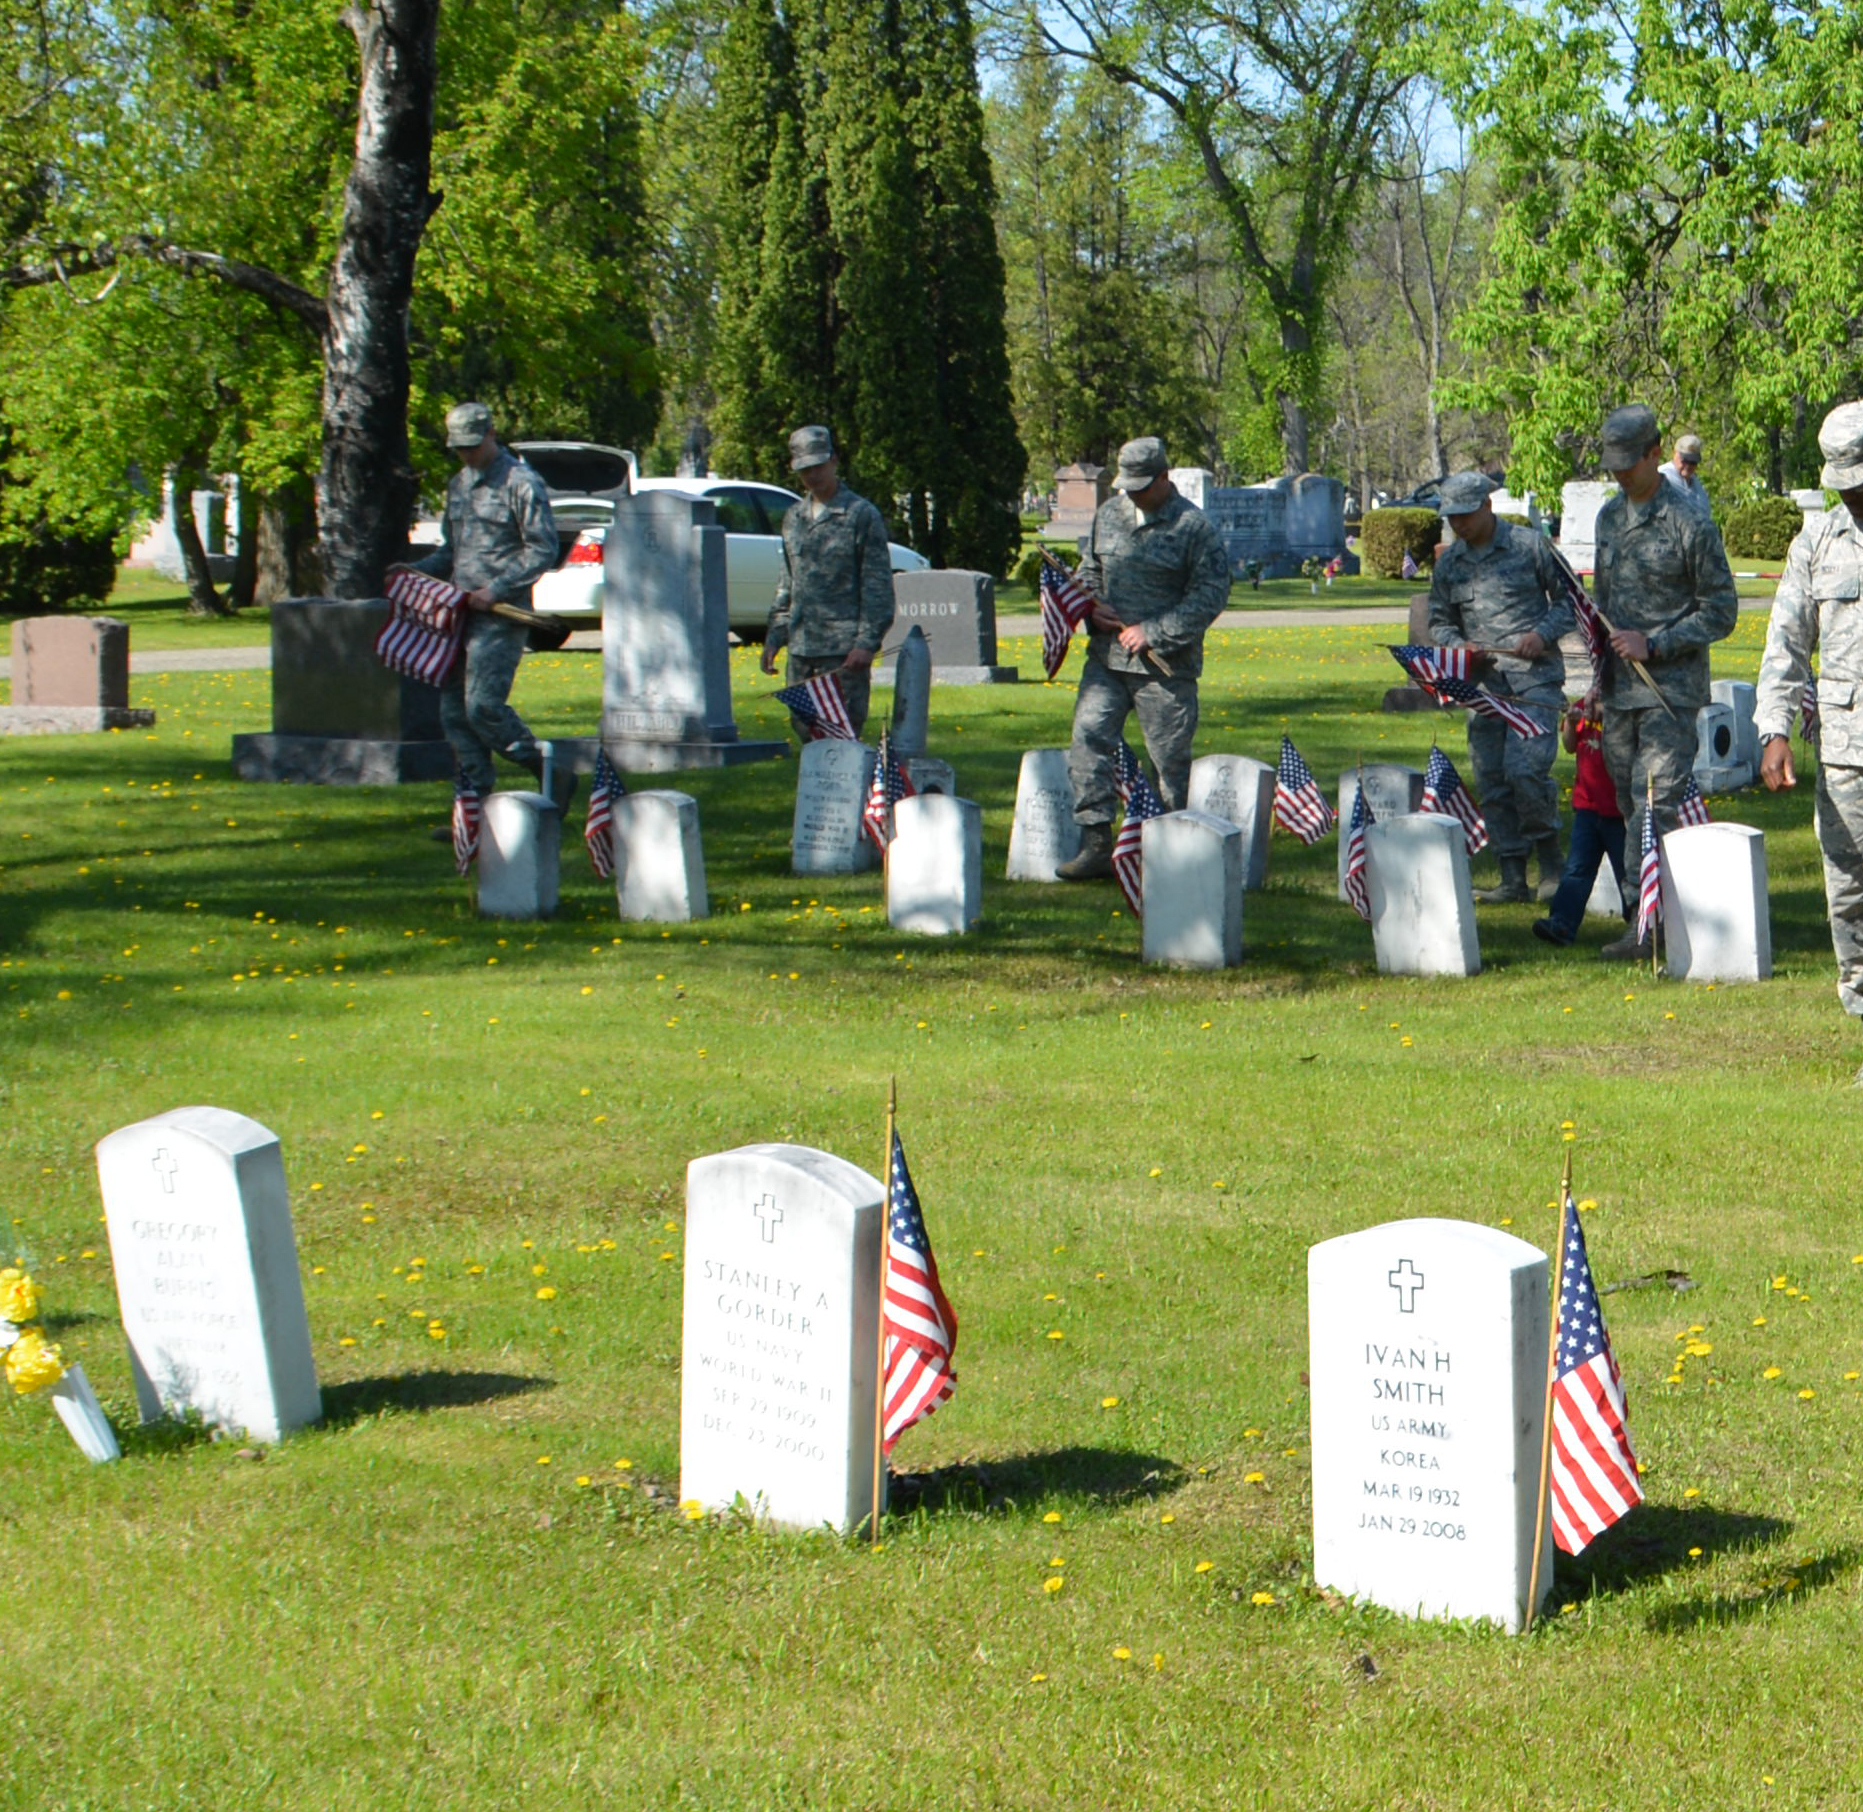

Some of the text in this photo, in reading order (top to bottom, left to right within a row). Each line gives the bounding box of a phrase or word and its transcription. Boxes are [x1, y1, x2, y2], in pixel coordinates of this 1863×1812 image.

[898, 602, 959, 617] MORROW
[132, 1220, 218, 1242] GREGORY
[703, 1258, 829, 1311] STANLEY A
[717, 1292, 813, 1337] GORDER
[727, 1330, 804, 1365] US NAVY
[1365, 1342, 1451, 1374] IVAN H
[699, 1352, 832, 1404] WORLD WAR II
[1373, 1378, 1444, 1407] SMITH
[713, 1386, 818, 1430] SEP 29 1909
[703, 1413, 737, 1438] DEC
[774, 1434, 825, 1462] 2000
[1371, 1414, 1447, 1438] US ARMY
[1380, 1449, 1441, 1471] KOREA
[1363, 1480, 1461, 1508] MAR 19 1932
[1357, 1512, 1467, 1542] JAN 29 2008
